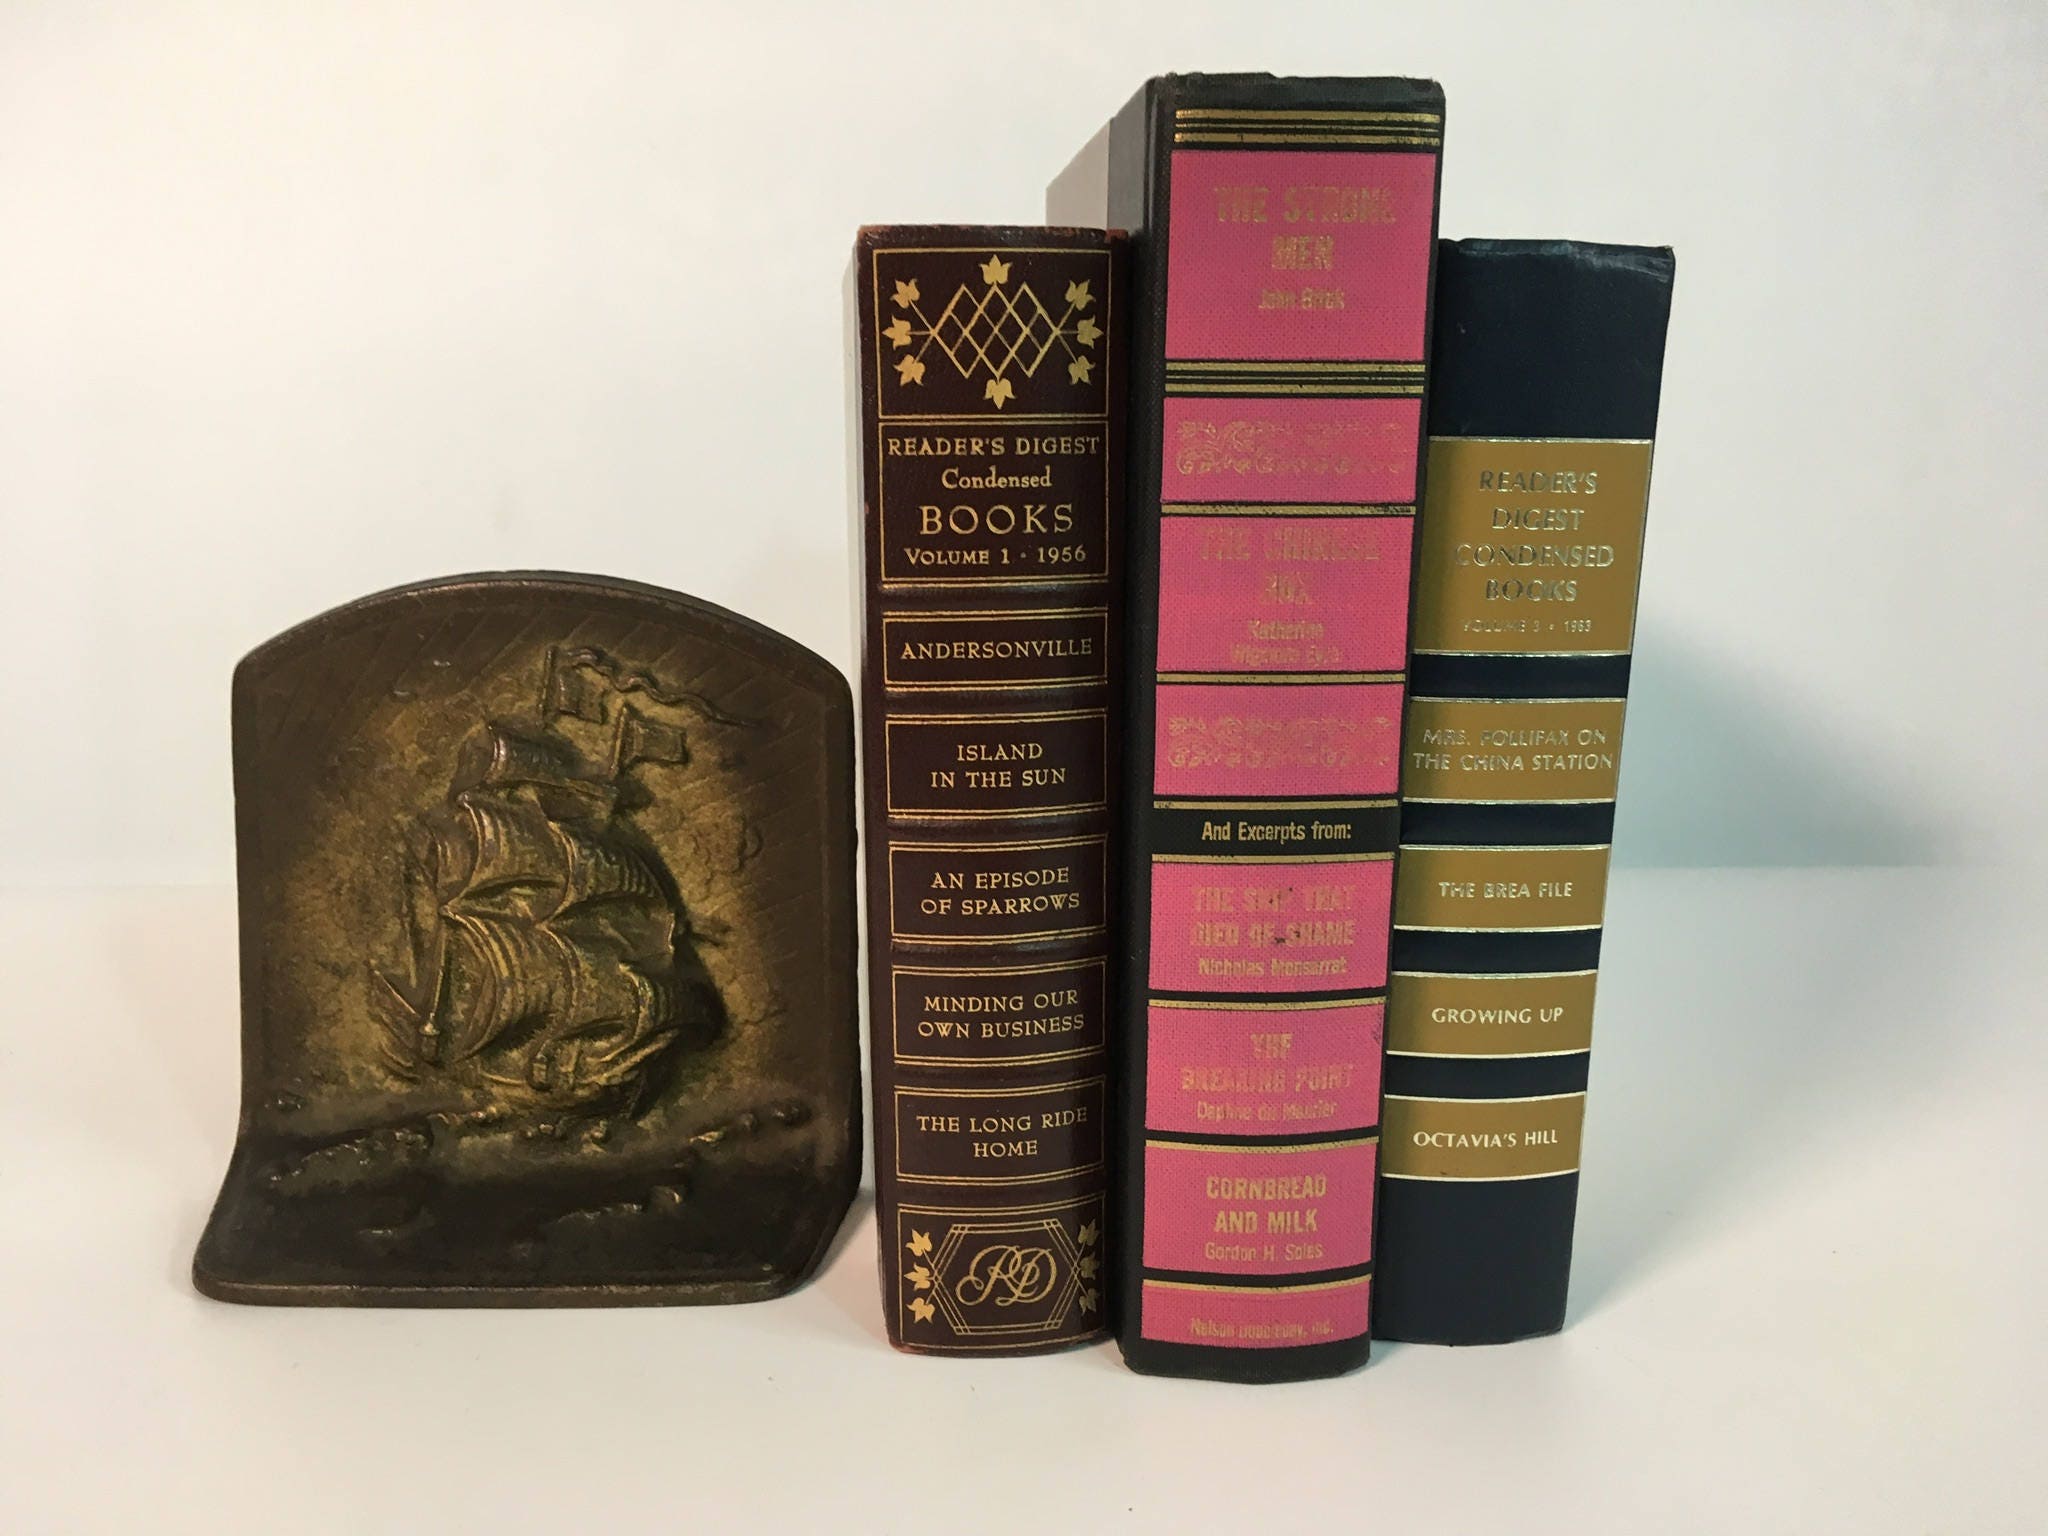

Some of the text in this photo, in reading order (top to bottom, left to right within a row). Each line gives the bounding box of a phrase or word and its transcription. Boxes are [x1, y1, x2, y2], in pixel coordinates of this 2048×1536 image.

[1214, 186, 1270, 223] THE
[1271, 235, 1334, 270] MEN
[888, 436, 1099, 456] READER'S DIGEST
[941, 466, 1052, 489] Condensed
[1479, 470, 1598, 494] READER'S
[919, 504, 1073, 535] BOOKS
[1492, 507, 1585, 531] DIGEST
[904, 548, 990, 566] VOLUME
[1037, 545, 1087, 563] 1956
[1455, 543, 1615, 567] CONDENSED
[1485, 579, 1579, 602] BOOKS
[900, 638, 1092, 660] ANDERSONVILLE
[1423, 729, 1471, 746] MRS.
[1577, 729, 1606, 746] ON
[956, 743, 1043, 762] ISLAND
[1413, 752, 1613, 771] THE CHINA STATION
[930, 768, 1066, 788] IN THE SUN
[1201, 820, 1352, 845] And Excerpts from:
[930, 867, 1070, 890] AN EPISODE
[1438, 881, 1573, 899] THE BREA FILE
[920, 892, 1080, 916] OF SPARROWS
[1190, 887, 1235, 912] THE
[1249, 922, 1275, 947] OF
[1285, 919, 1355, 946] SHAME
[1199, 958, 1265, 976] Nicholas
[924, 989, 1079, 1014] MINDING OUR
[917, 1013, 1085, 1039] OWN BUSINESS
[1431, 1007, 1564, 1025] GROWING UP
[916, 1107, 1089, 1135] THE LONG RIDE
[973, 1139, 1038, 1159] HOME
[1412, 1129, 1558, 1149] OCTAVIA'S HILL
[1206, 1175, 1327, 1200] CORNBREAD
[1214, 1209, 1317, 1233] AND MILK
[1205, 1242, 1257, 1261] Gordon
